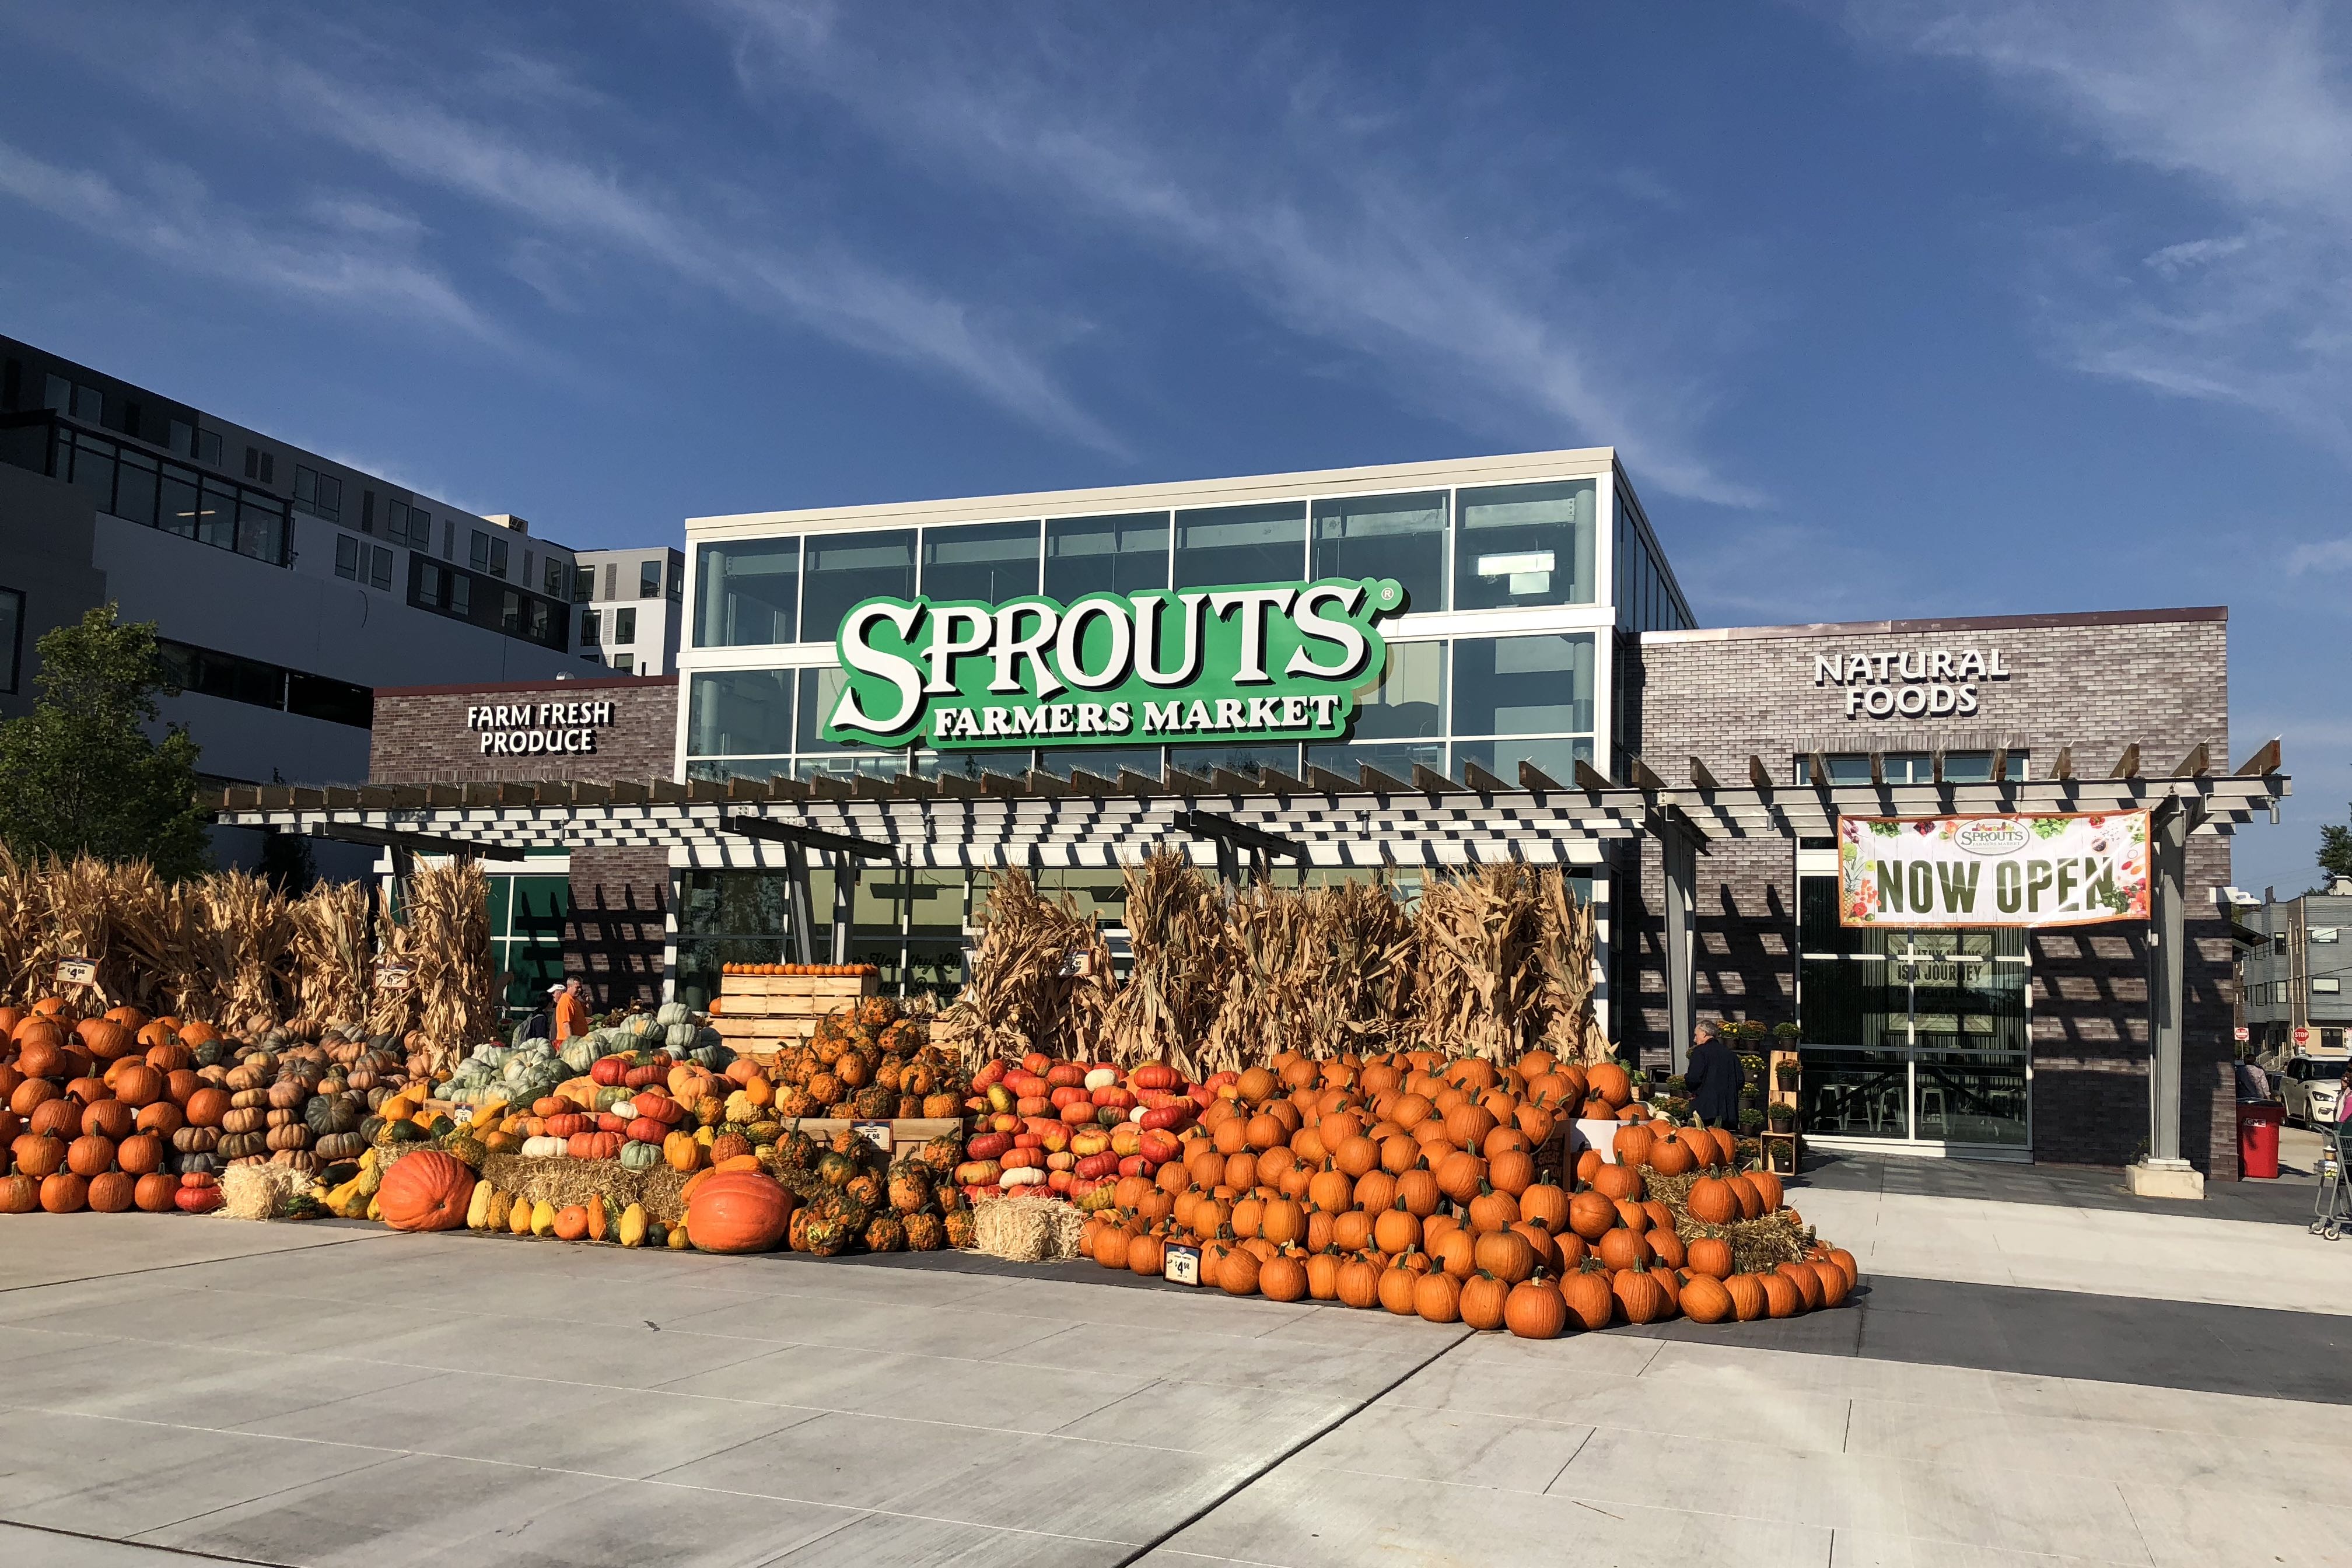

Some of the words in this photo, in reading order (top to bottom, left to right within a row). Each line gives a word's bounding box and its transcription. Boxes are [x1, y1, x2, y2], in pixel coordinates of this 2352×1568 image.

[830, 585, 1364, 733] SPROUTS
[1814, 648, 2010, 682] NATURAL
[467, 705, 531, 728] FARM
[540, 702, 610, 724] FRESH
[1846, 684, 1977, 715] FOODS
[933, 702, 1132, 737] FARMERS
[1142, 695, 1338, 731] MARKET
[480, 729, 592, 753] PRODUCE
[1961, 831, 2024, 846] SPROUTS
[1877, 860, 1981, 914] NOW
[1996, 856, 2114, 914] OPEN
[1898, 964, 1909, 980] IS
[1913, 964, 1921, 980] A
